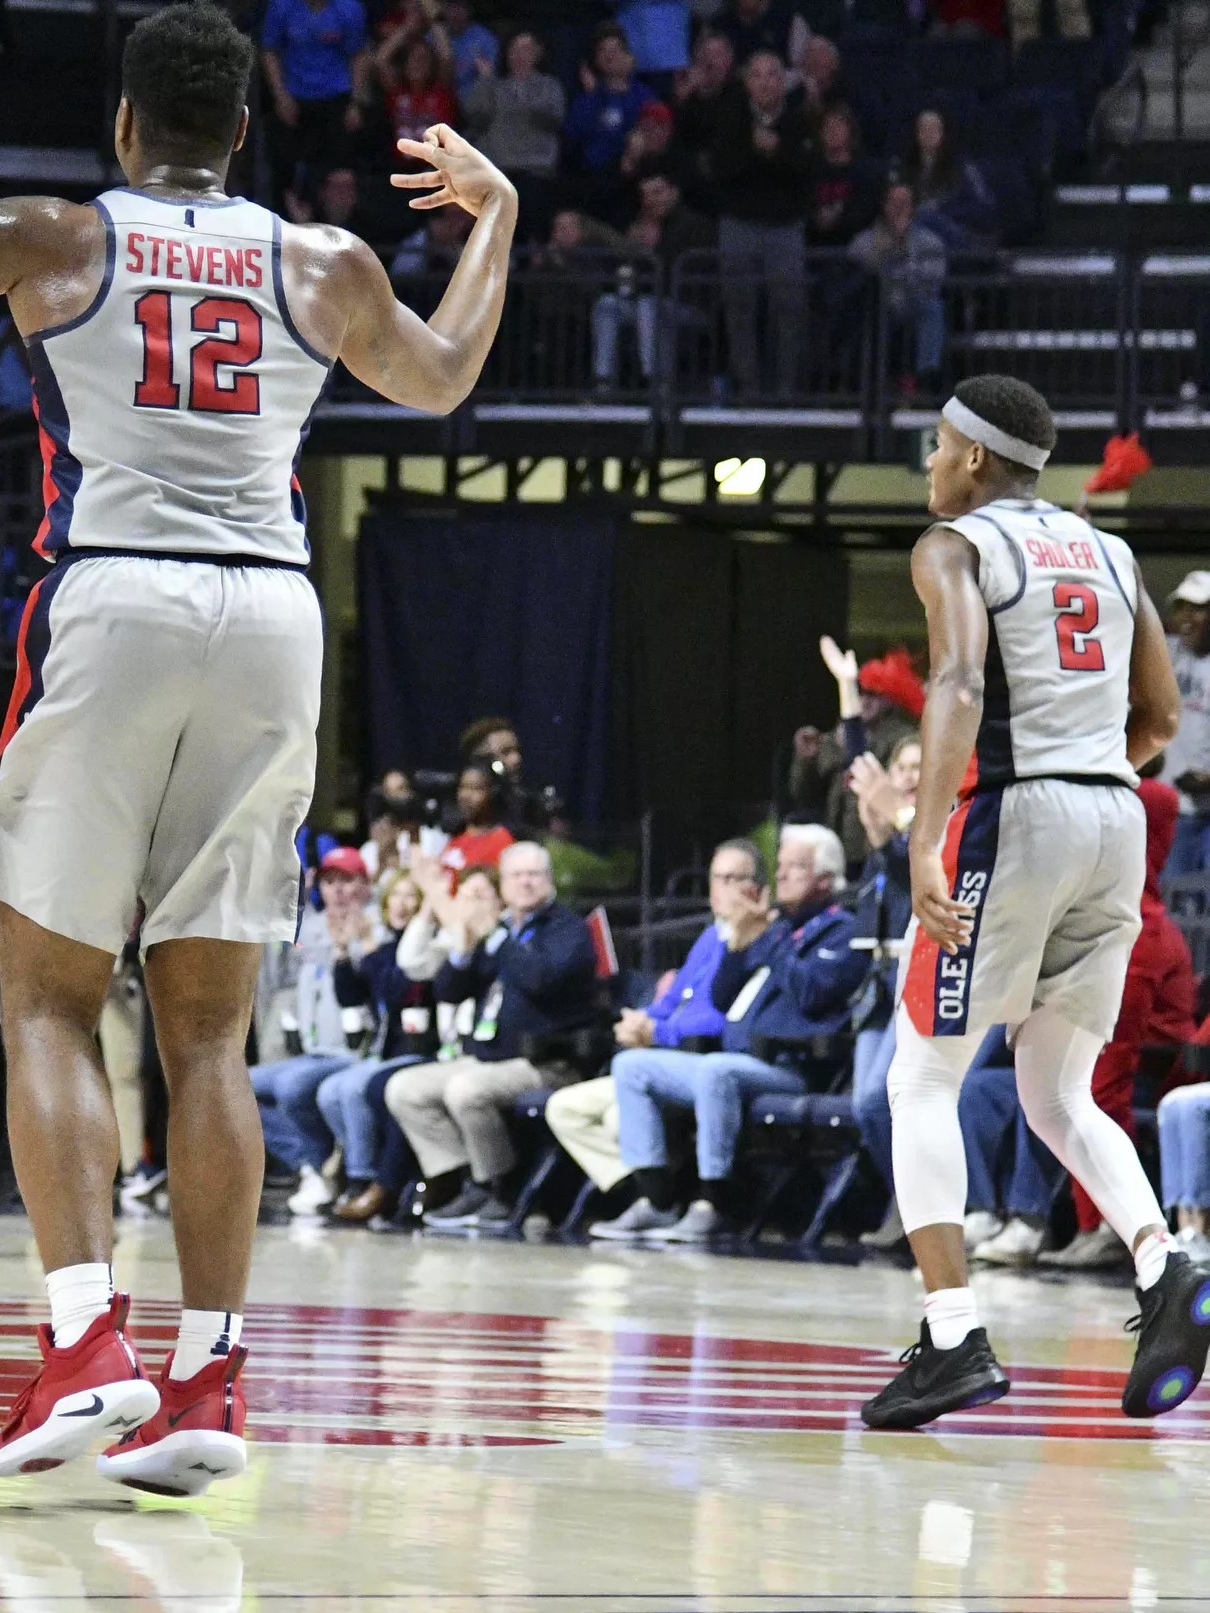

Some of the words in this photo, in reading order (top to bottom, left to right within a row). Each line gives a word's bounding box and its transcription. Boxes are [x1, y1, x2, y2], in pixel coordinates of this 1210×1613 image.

[126, 232, 262, 288] STEVENS
[133, 289, 262, 415] 12
[1025, 538, 1099, 570] SHULER
[1052, 582, 1105, 671] 2
[938, 957, 968, 1019] OLE
